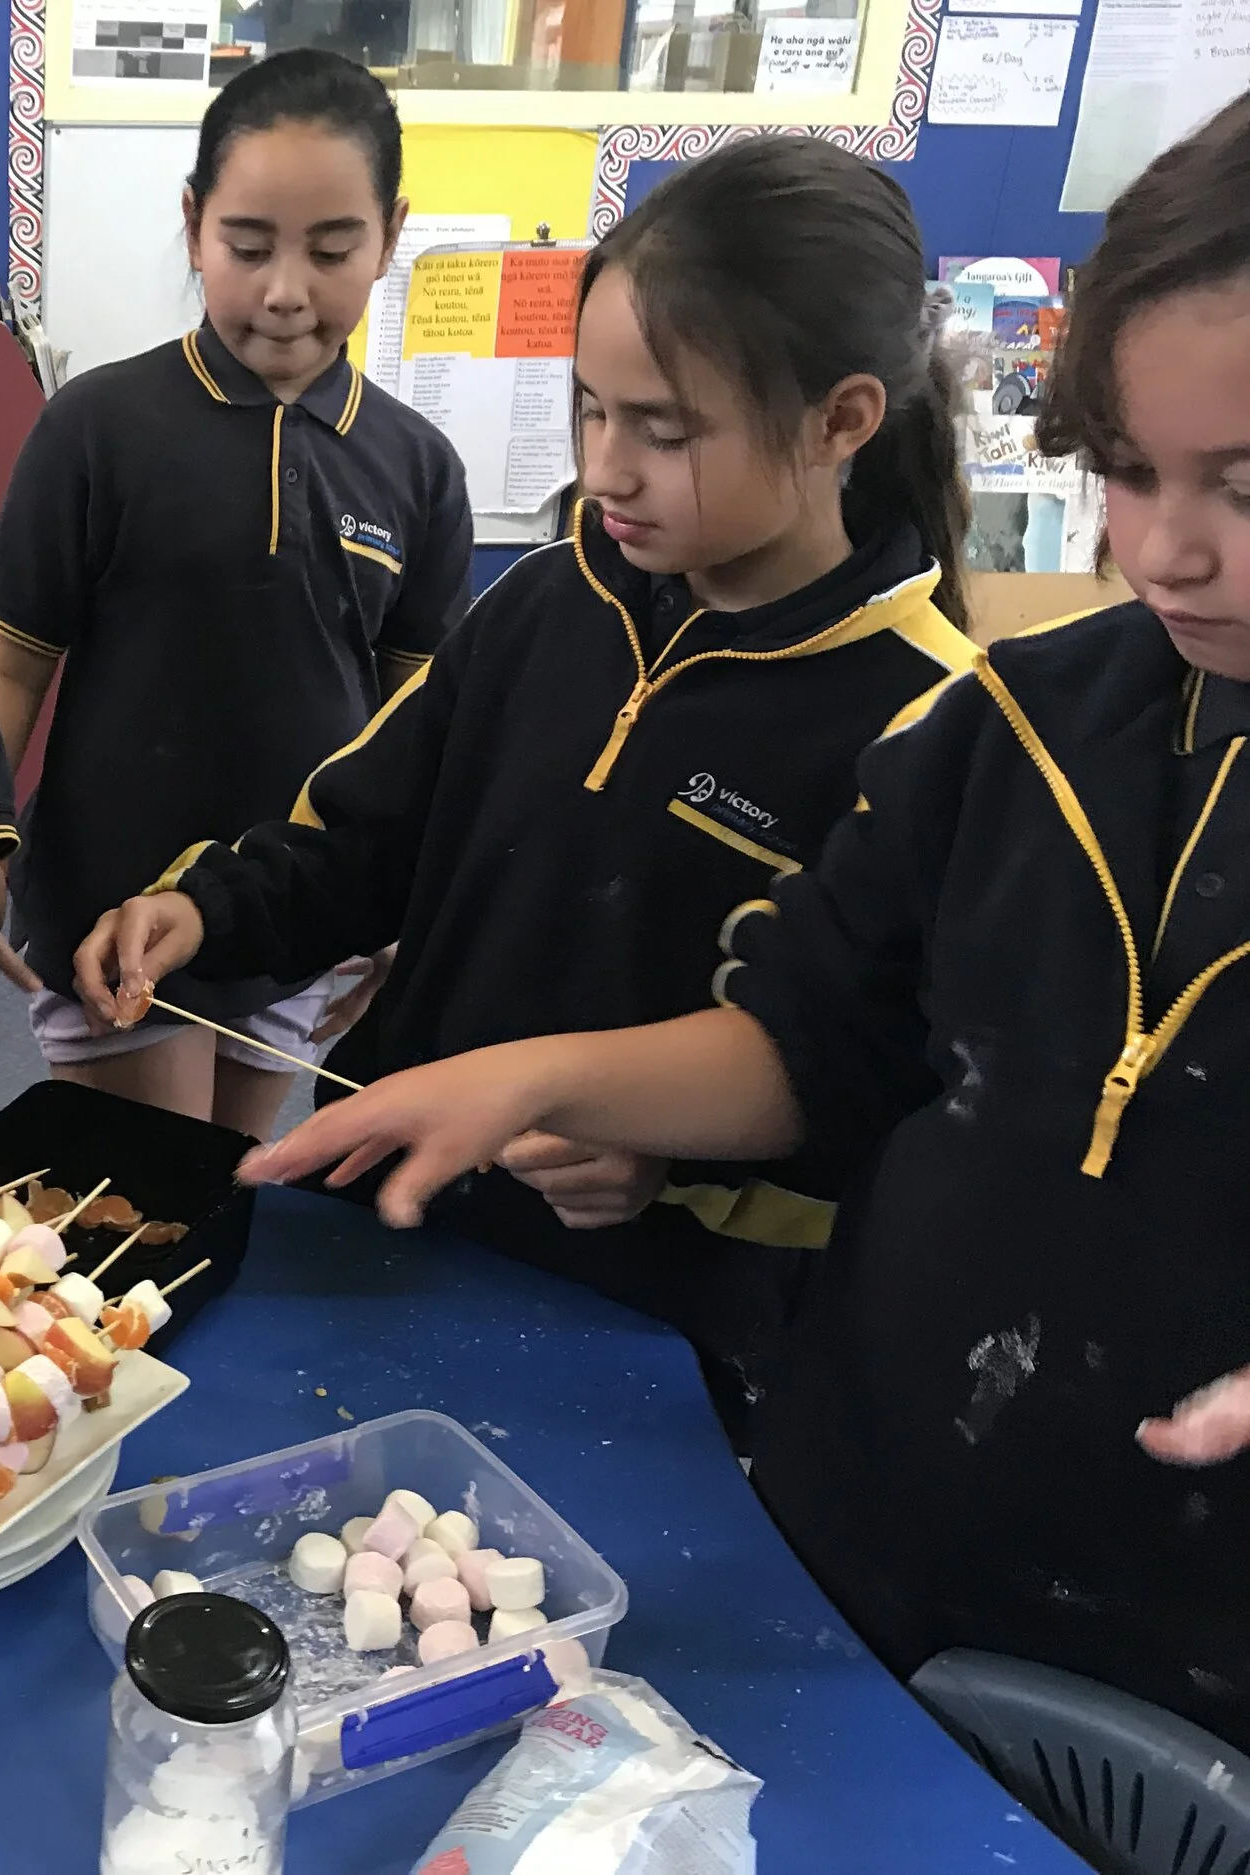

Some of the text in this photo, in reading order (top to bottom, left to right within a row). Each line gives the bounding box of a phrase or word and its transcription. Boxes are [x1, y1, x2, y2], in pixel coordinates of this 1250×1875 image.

[770, 35, 783, 44] He
[786, 34, 804, 44] aha
[447, 258, 466, 269] taku
[468, 257, 499, 268] kōrero
[520, 271, 550, 282] kōrero
[966, 271, 1033, 284] Tangaroa's Gift
[422, 286, 484, 297] Nō reira, tēnā
[434, 300, 469, 310] koutou,
[514, 299, 527, 308] Nō
[530, 299, 554, 309] reira,
[412, 312, 491, 324] Tēnā koutou, tēnā
[514, 311, 550, 322] koutou,
[501, 325, 535, 336] koutou,
[972, 423, 1011, 448] Kiwi
[978, 438, 1018, 464] Tahi
[1027, 452, 1067, 475] Kiwi
[358, 521, 392, 543] victory
[718, 787, 779, 829] victory
